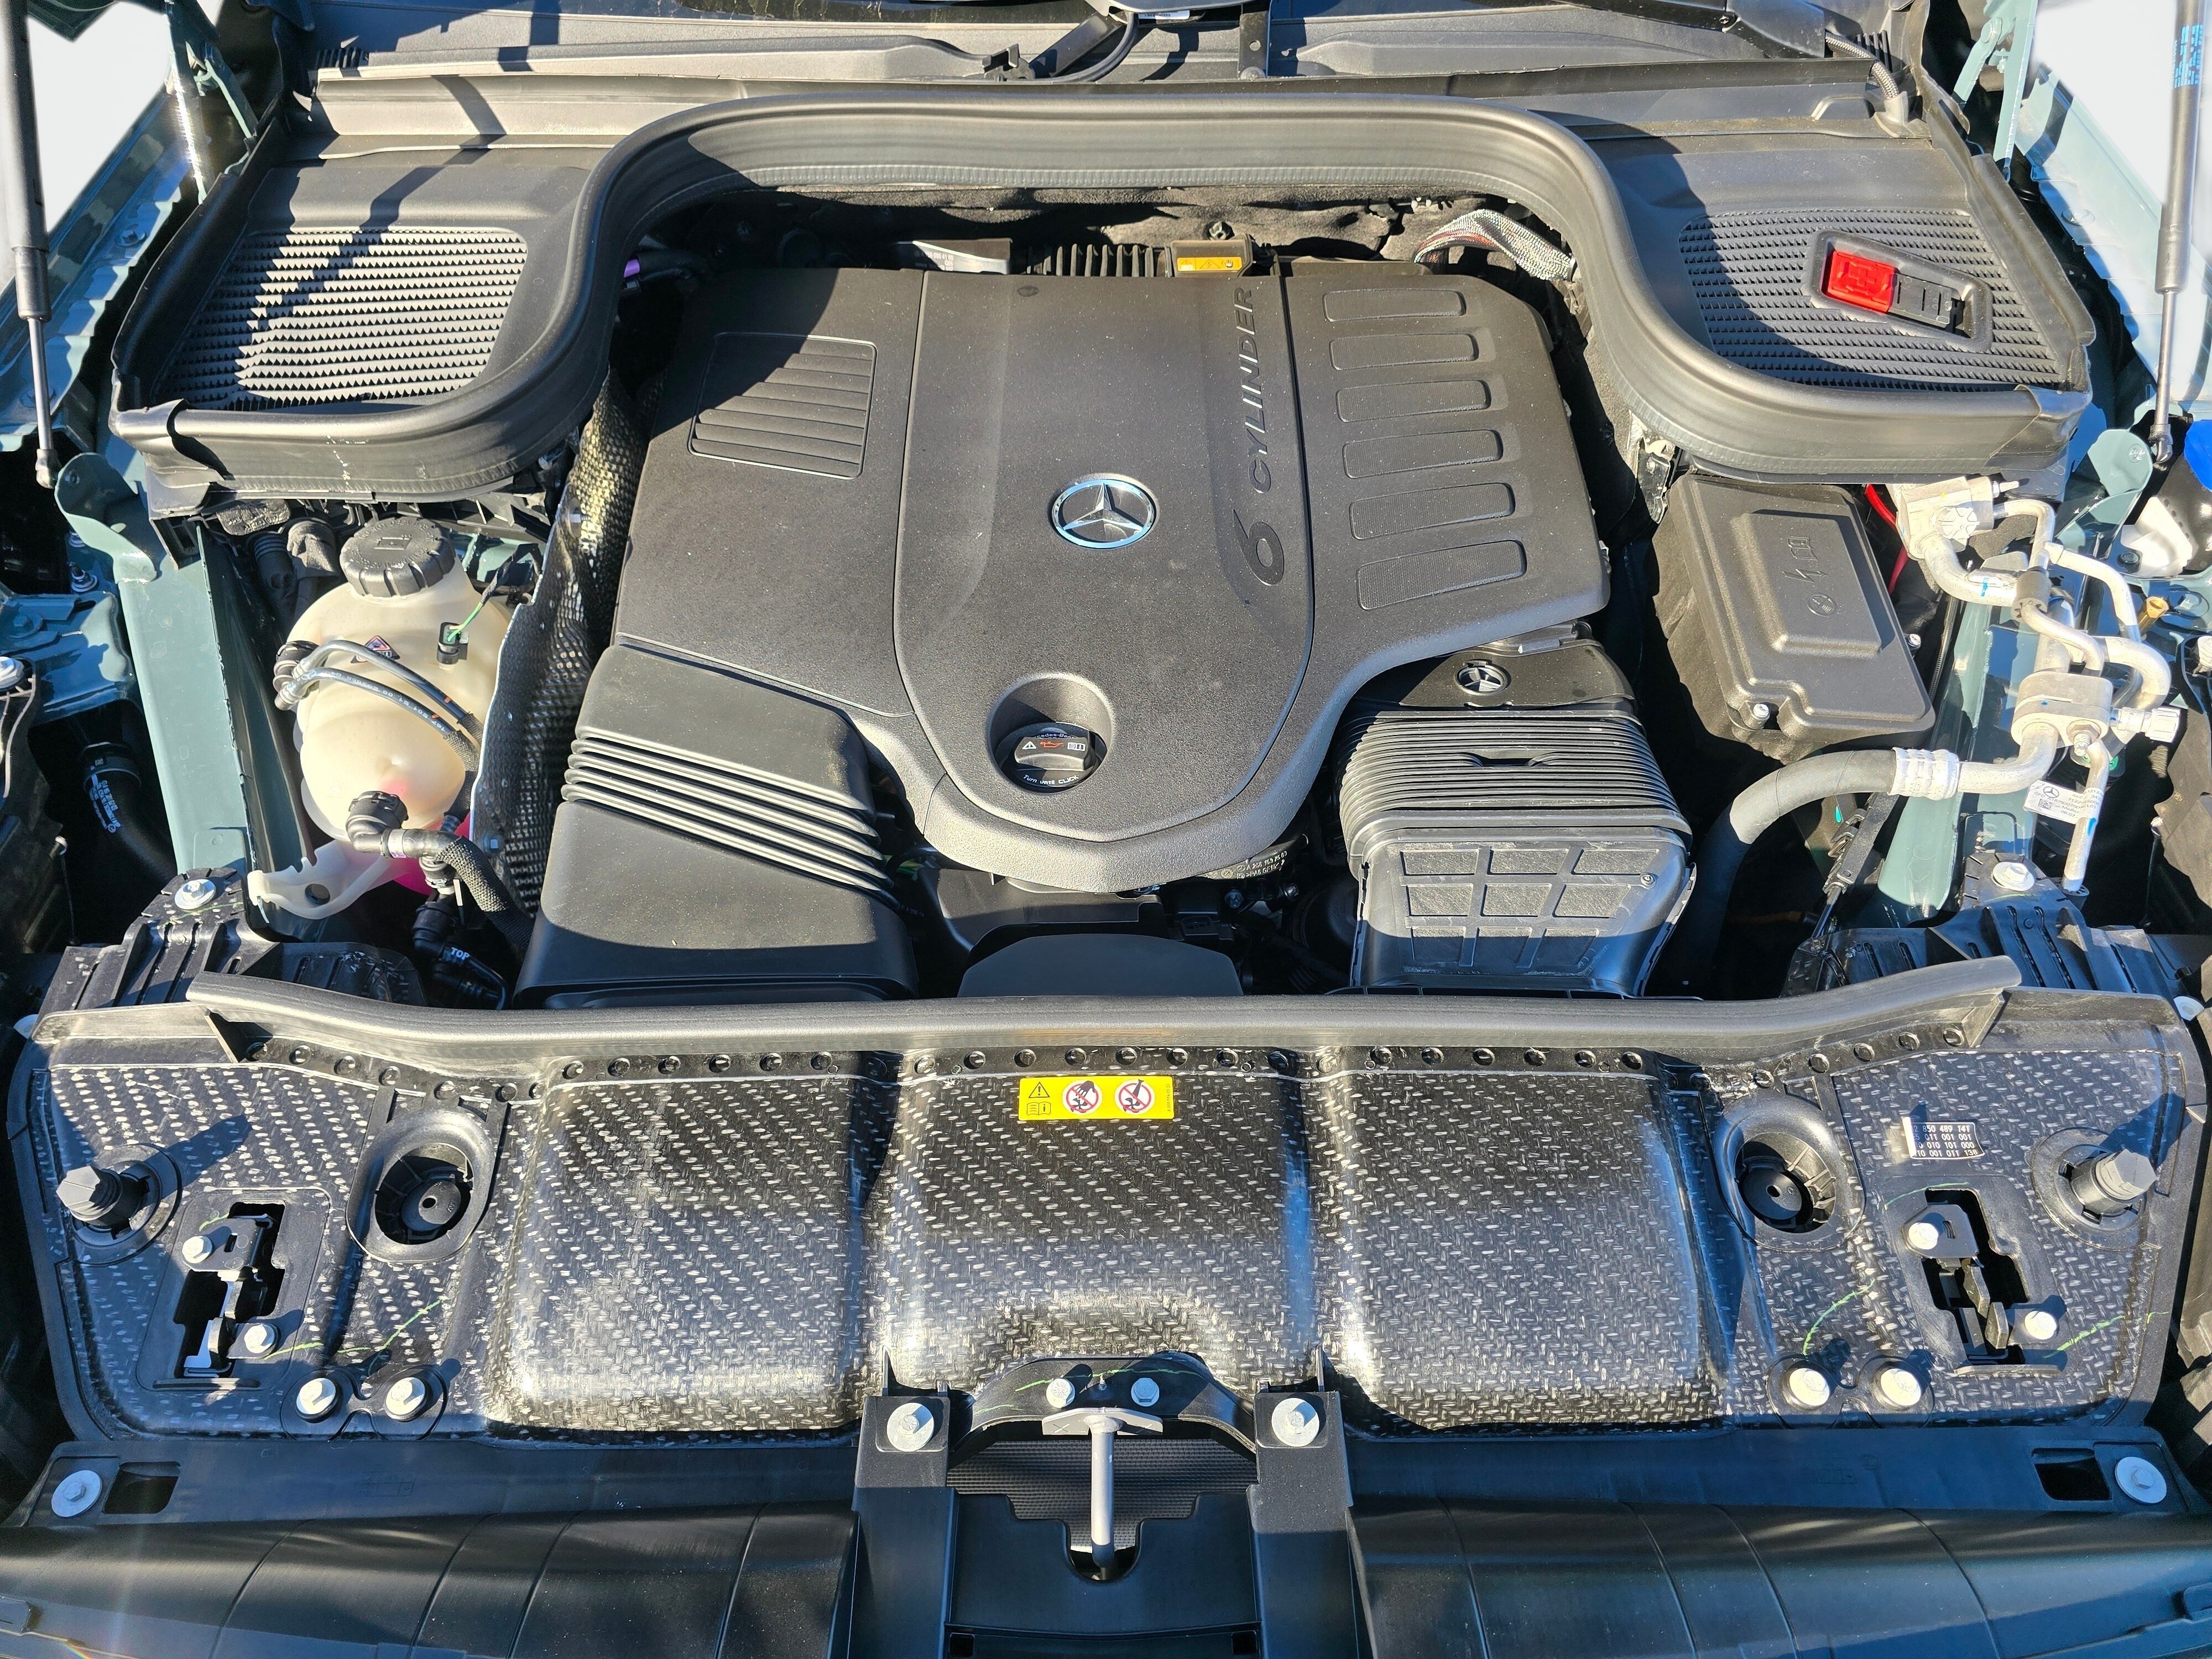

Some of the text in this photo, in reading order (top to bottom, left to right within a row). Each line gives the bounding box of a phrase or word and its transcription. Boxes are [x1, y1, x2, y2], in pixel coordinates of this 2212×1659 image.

[1232, 286, 1285, 586] 6 CYLINDER
[1022, 774, 1038, 783] Turn
[1058, 775, 1079, 784] CLICK
[451, 947, 471, 960] TOP
